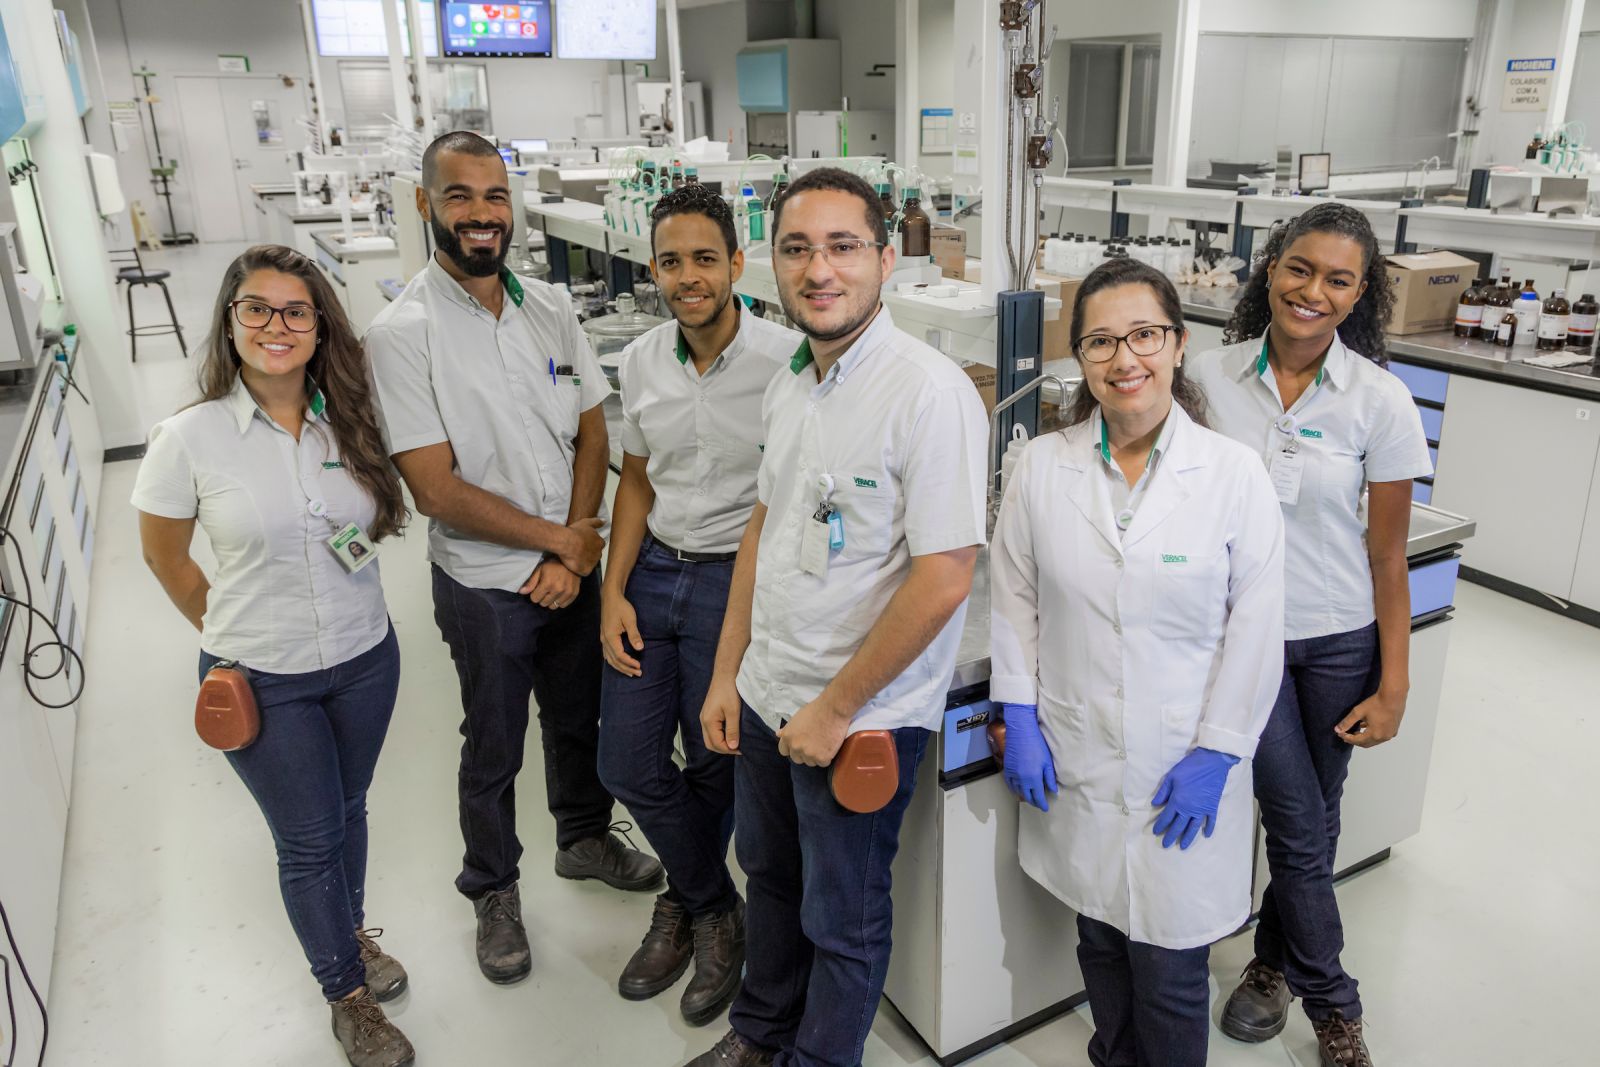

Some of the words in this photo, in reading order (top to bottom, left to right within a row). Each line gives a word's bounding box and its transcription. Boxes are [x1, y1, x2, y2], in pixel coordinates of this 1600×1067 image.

[1511, 60, 1553, 70] HIGIENE
[1428, 274, 1460, 286] NEON
[853, 476, 877, 487] VERACEL
